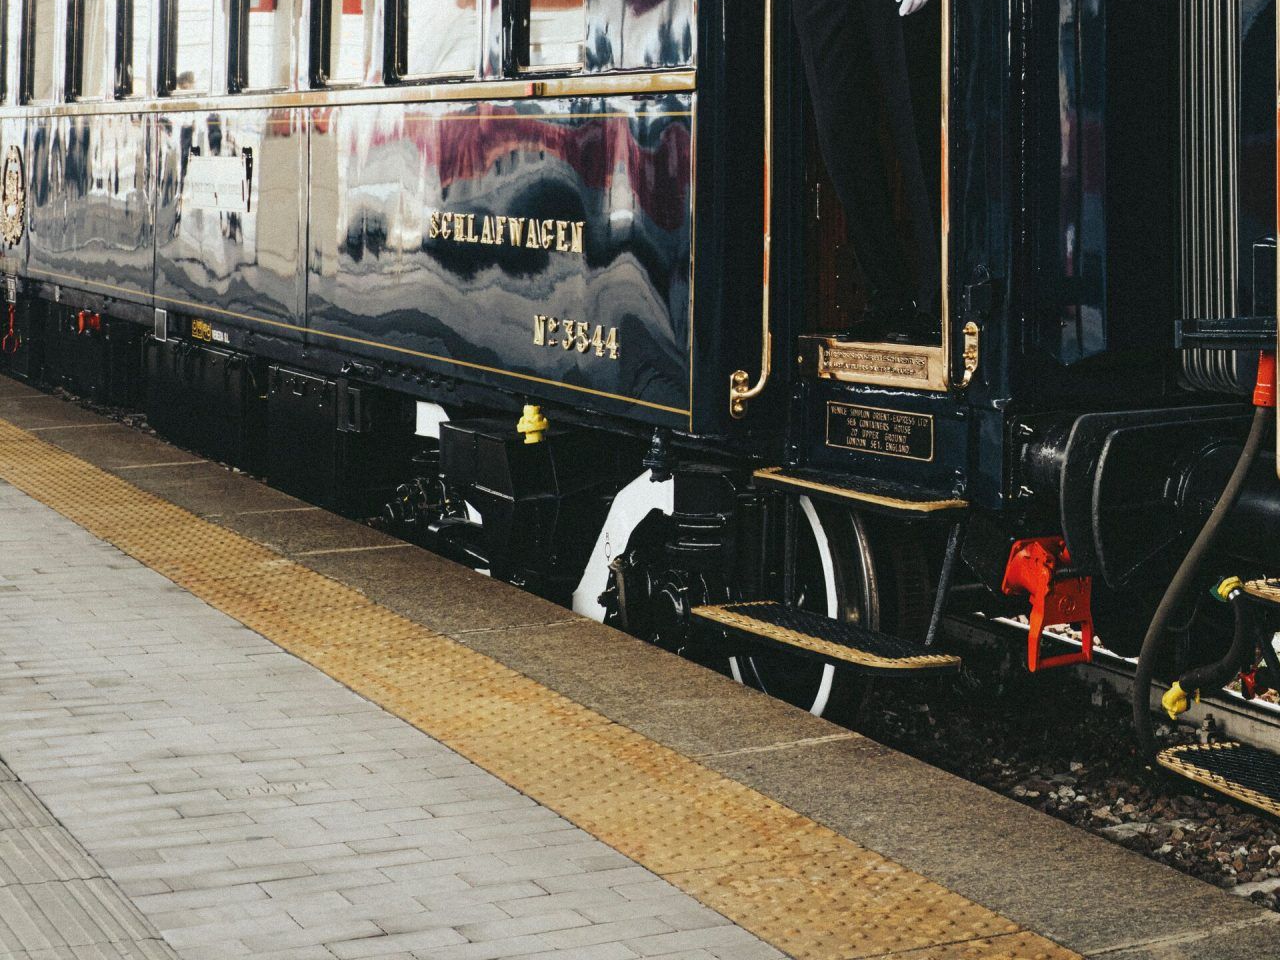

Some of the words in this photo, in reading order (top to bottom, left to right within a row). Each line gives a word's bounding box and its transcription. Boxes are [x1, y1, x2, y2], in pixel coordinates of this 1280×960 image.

[429, 211, 586, 254] SCHLAFWAGEN
[562, 319, 620, 360] 3544
[846, 436, 867, 447] LONDON
[893, 424, 911, 435] HOUSE
